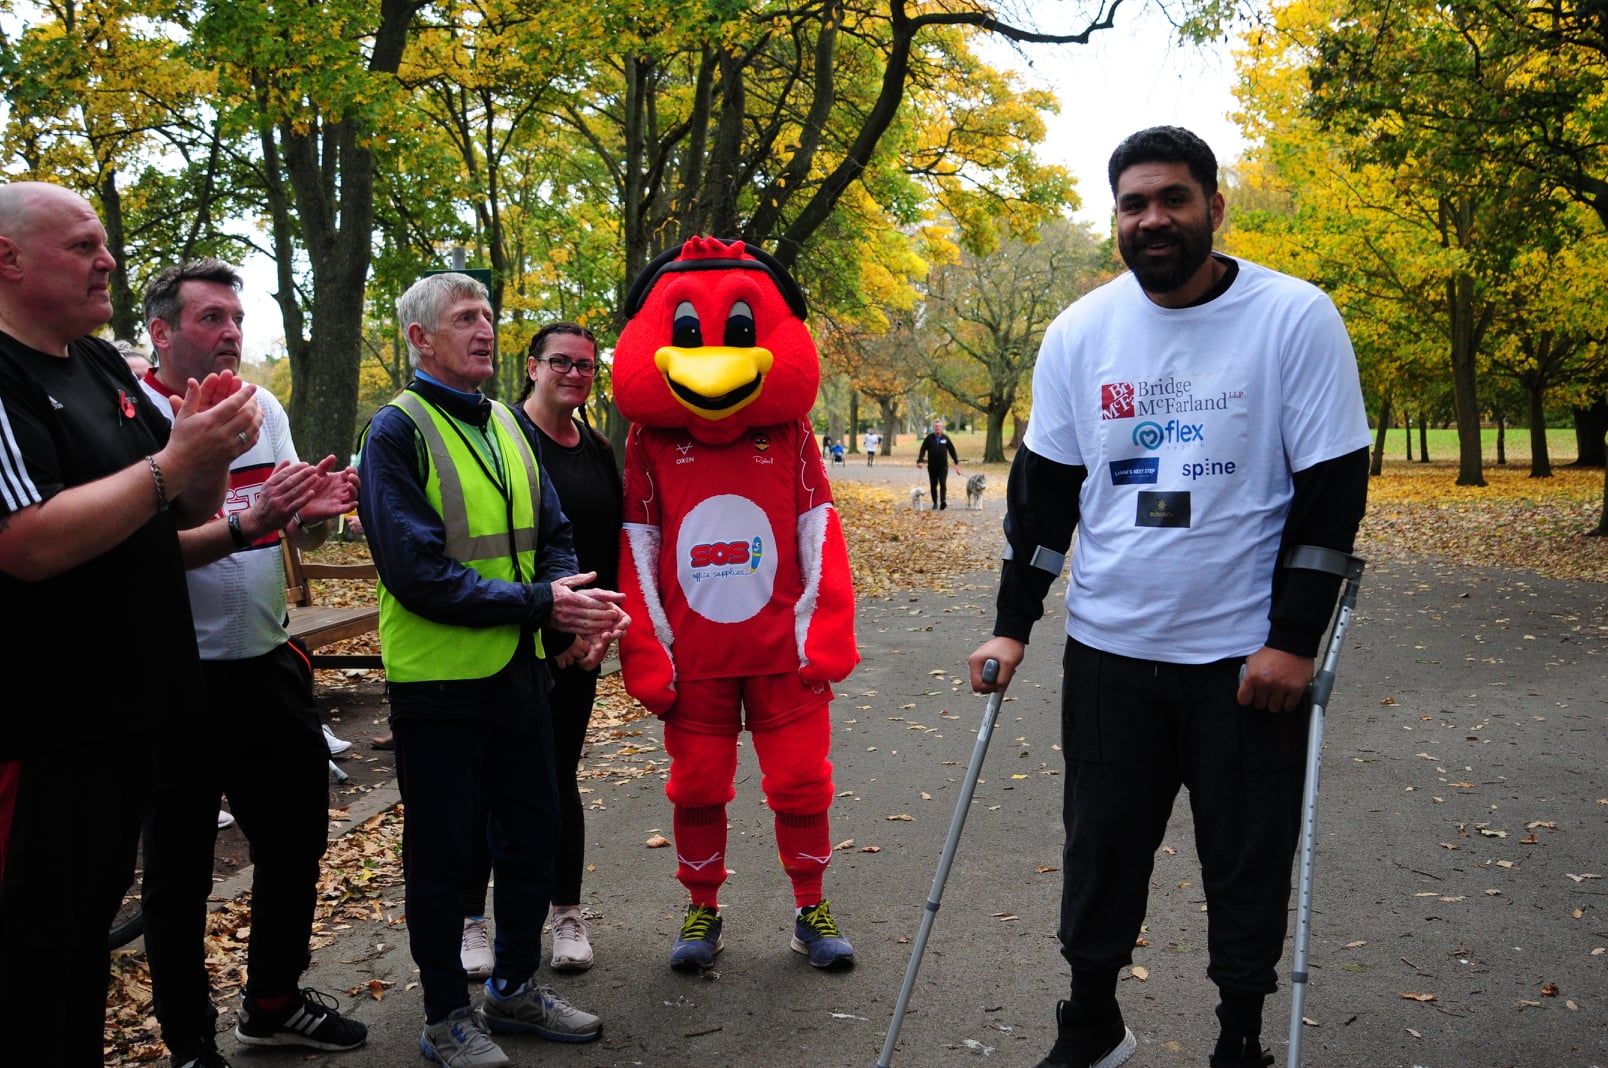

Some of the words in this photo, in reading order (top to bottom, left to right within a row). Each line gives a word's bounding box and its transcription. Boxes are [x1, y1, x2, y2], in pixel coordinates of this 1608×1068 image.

[1138, 377, 1191, 398] Bridge
[1138, 391, 1228, 416] McFarland
[1165, 419, 1204, 443] flex
[690, 541, 750, 568] SOS
[691, 571, 710, 582] office
[713, 567, 746, 579] supplies
